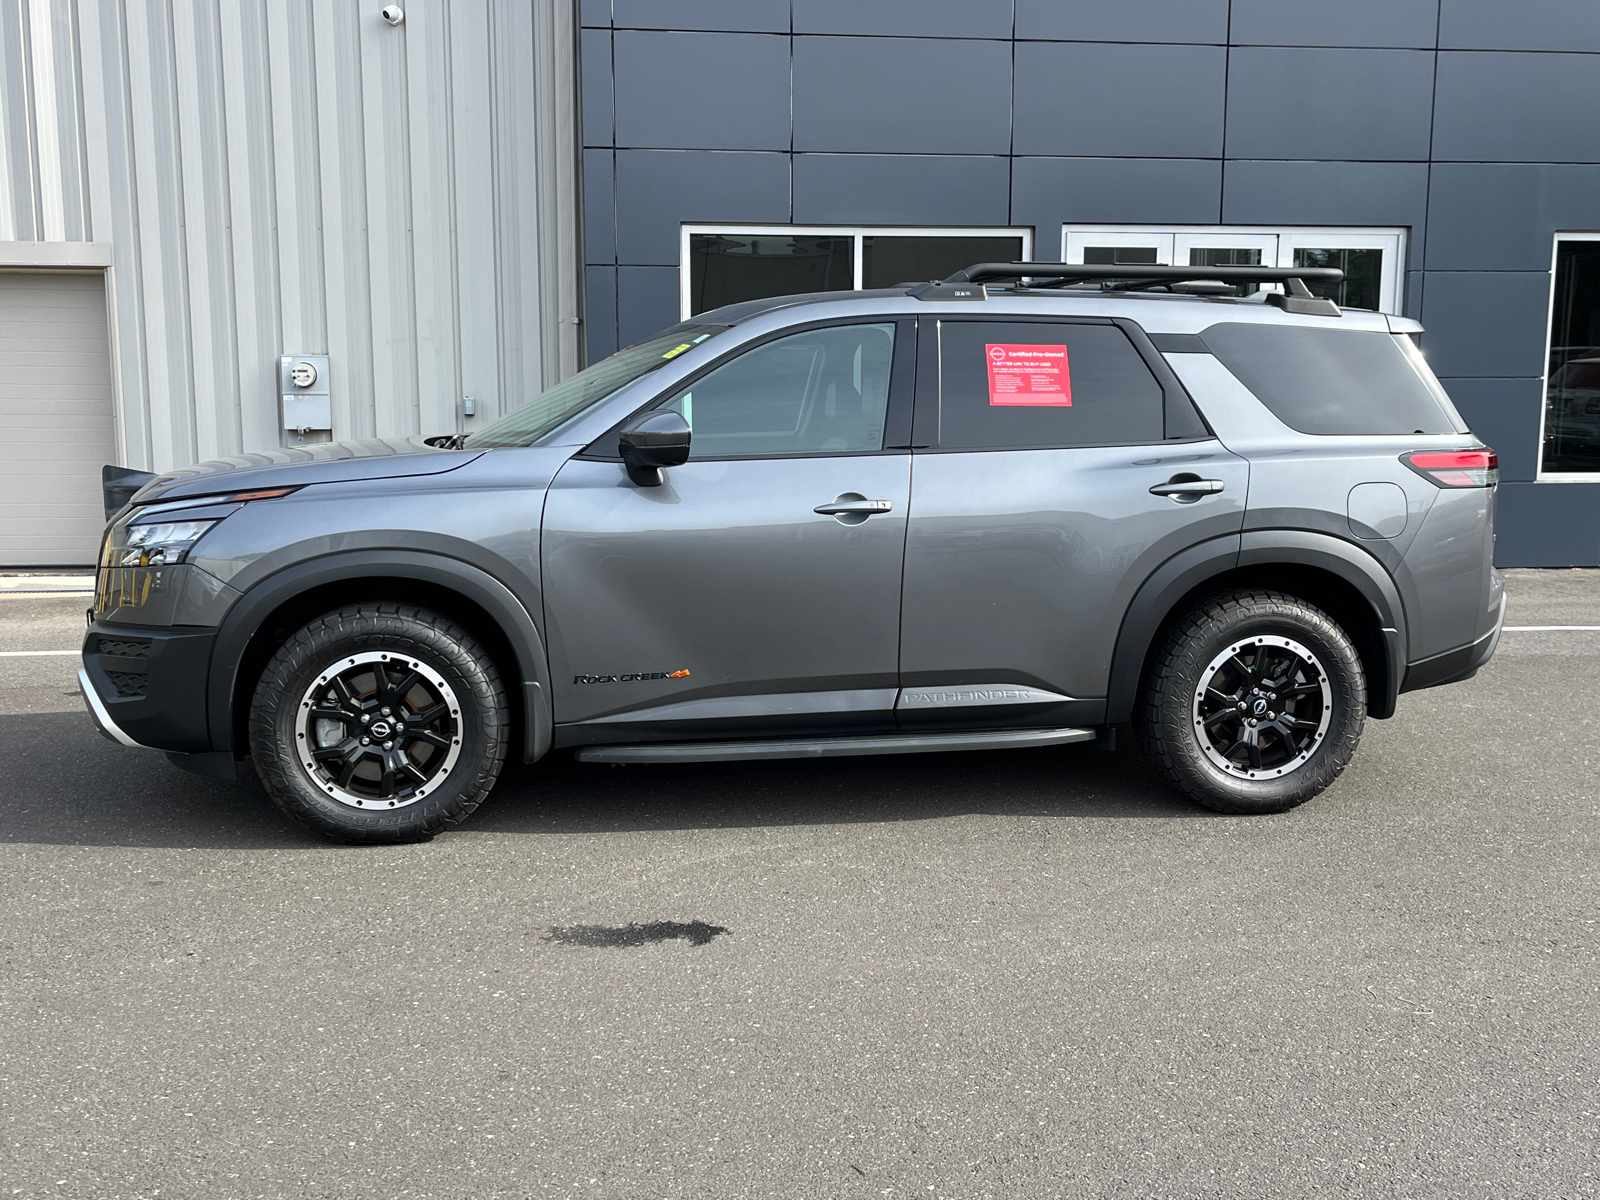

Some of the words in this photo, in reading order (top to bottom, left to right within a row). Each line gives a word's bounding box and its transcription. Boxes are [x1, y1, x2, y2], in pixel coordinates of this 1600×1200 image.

[354, 634, 414, 647] TOYO
[573, 674, 617, 684] ROCK
[620, 671, 670, 682] CREEK
[904, 689, 1030, 704] PATHFINDER
[1332, 672, 1351, 755] COUNTRY
[1179, 715, 1201, 764] TOYO
[294, 785, 382, 828] COUNTRY
[385, 801, 440, 827] OPEN
